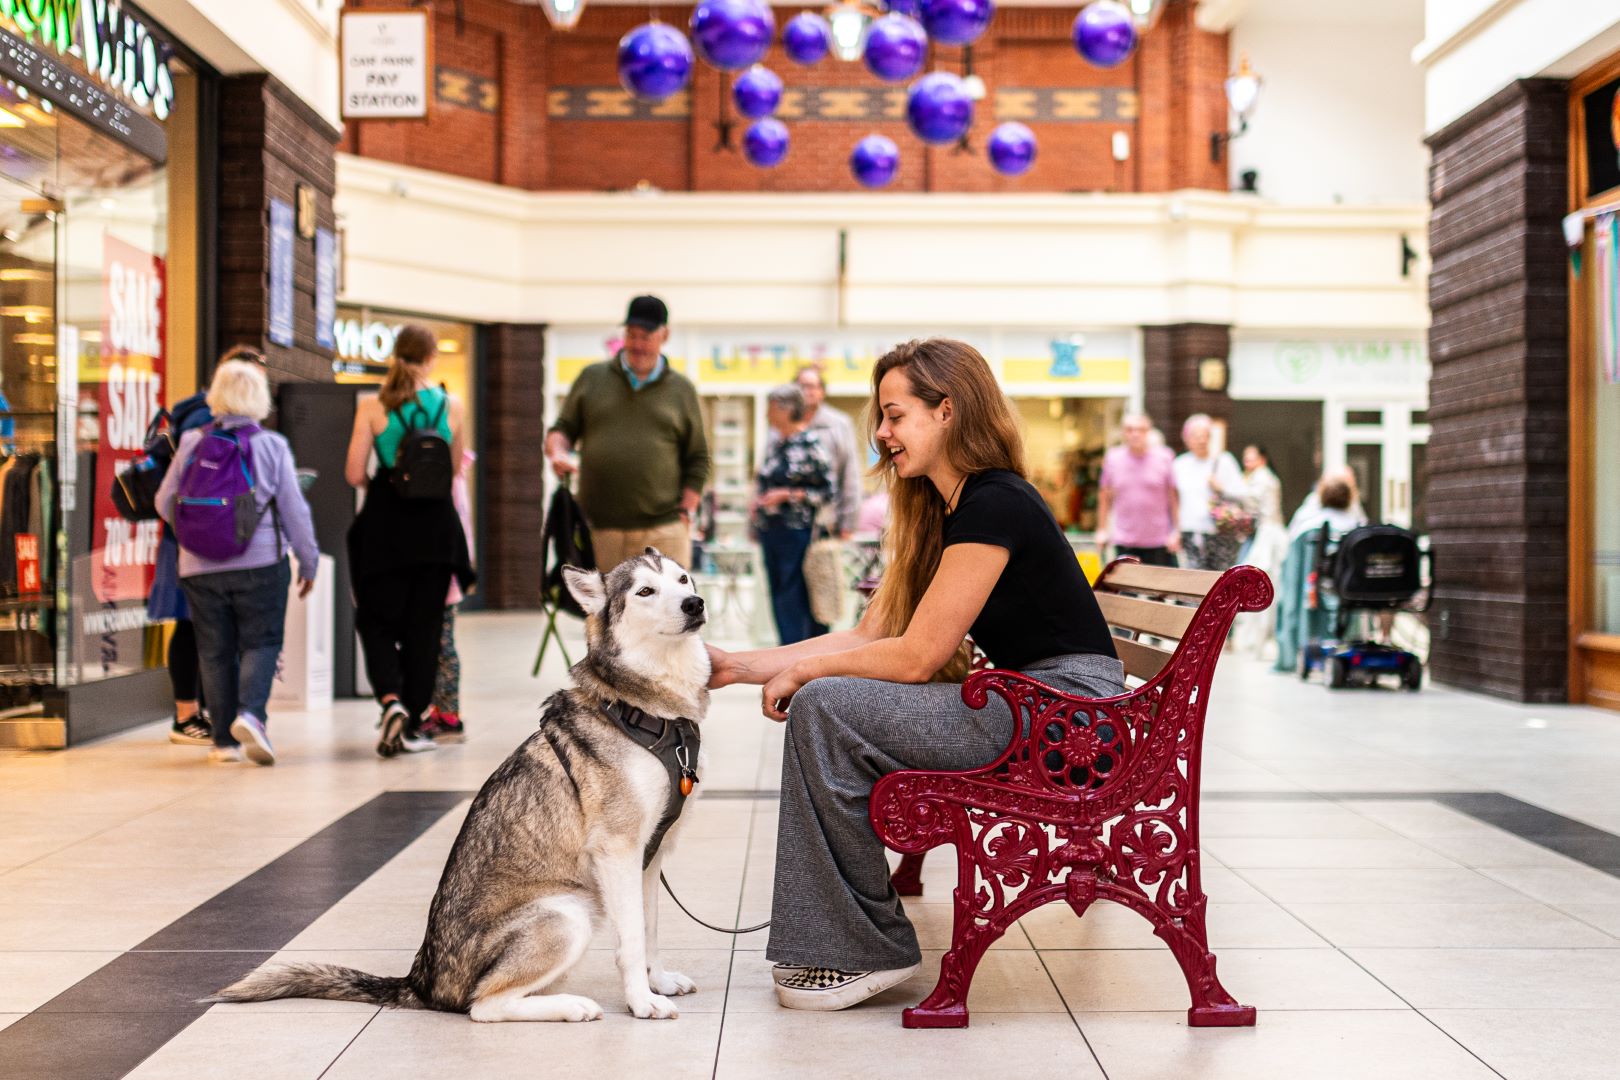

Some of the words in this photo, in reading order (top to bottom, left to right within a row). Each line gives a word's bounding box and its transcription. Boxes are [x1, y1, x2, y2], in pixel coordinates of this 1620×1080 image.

[350, 56, 376, 67] CAR
[381, 55, 415, 66] PARK
[366, 72, 398, 86] PAY
[350, 92, 418, 108] STATION
[109, 261, 162, 358] SALE
